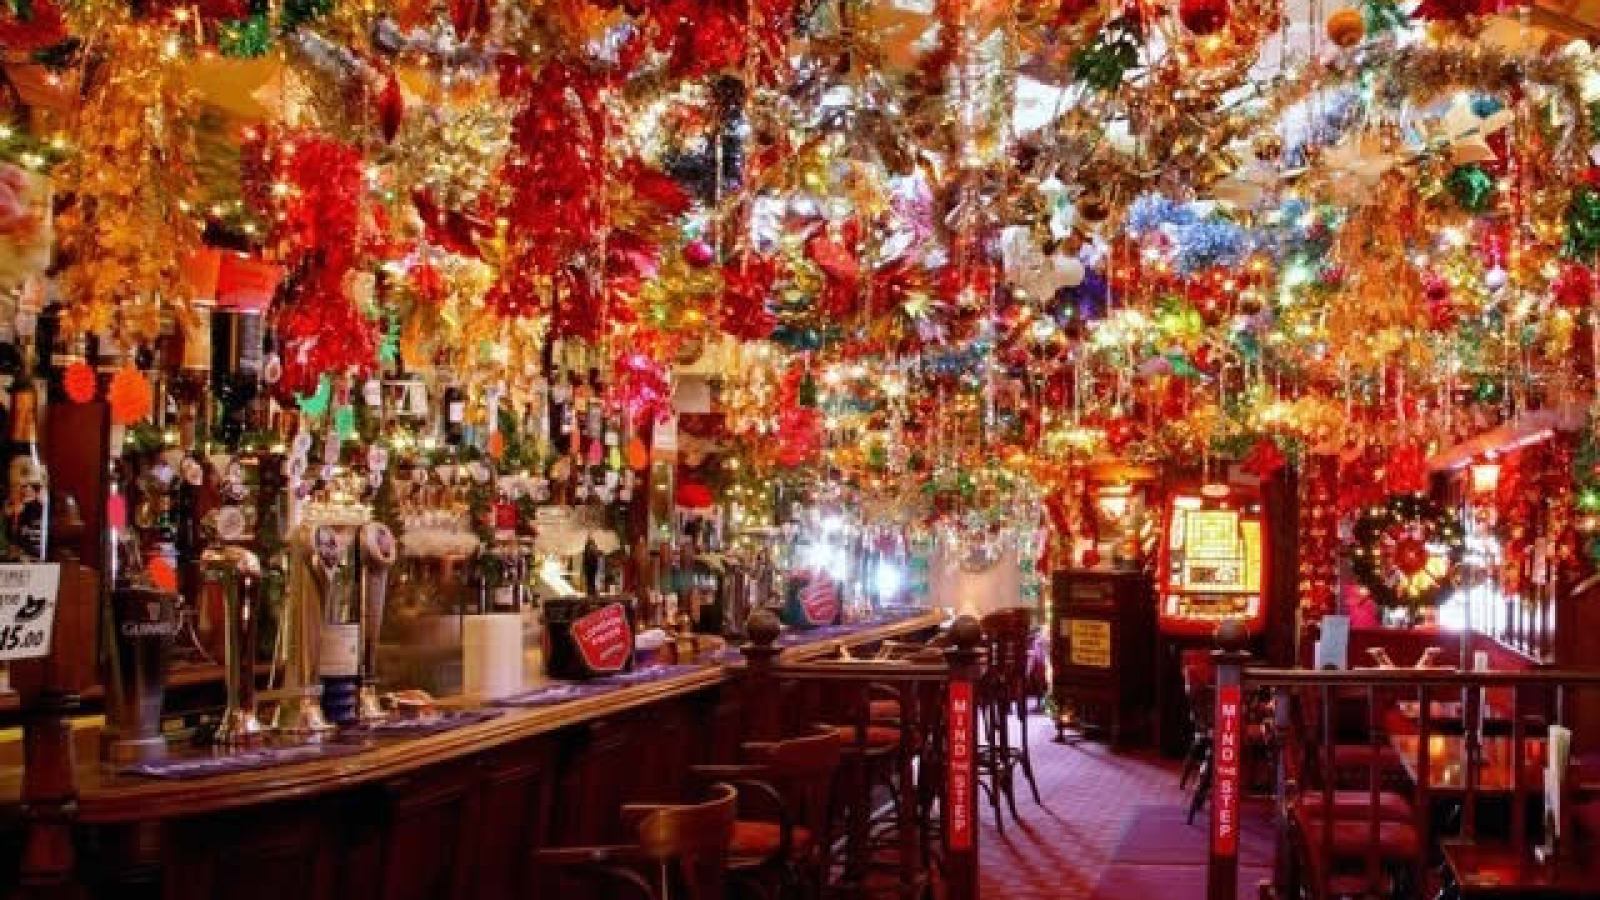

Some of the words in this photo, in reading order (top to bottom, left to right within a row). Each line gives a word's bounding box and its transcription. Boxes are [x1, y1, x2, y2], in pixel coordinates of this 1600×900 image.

[954, 698, 967, 757] MIND
[1221, 704, 1236, 761] MIND
[954, 774, 967, 833] STEP
[1219, 779, 1233, 838] STEP
